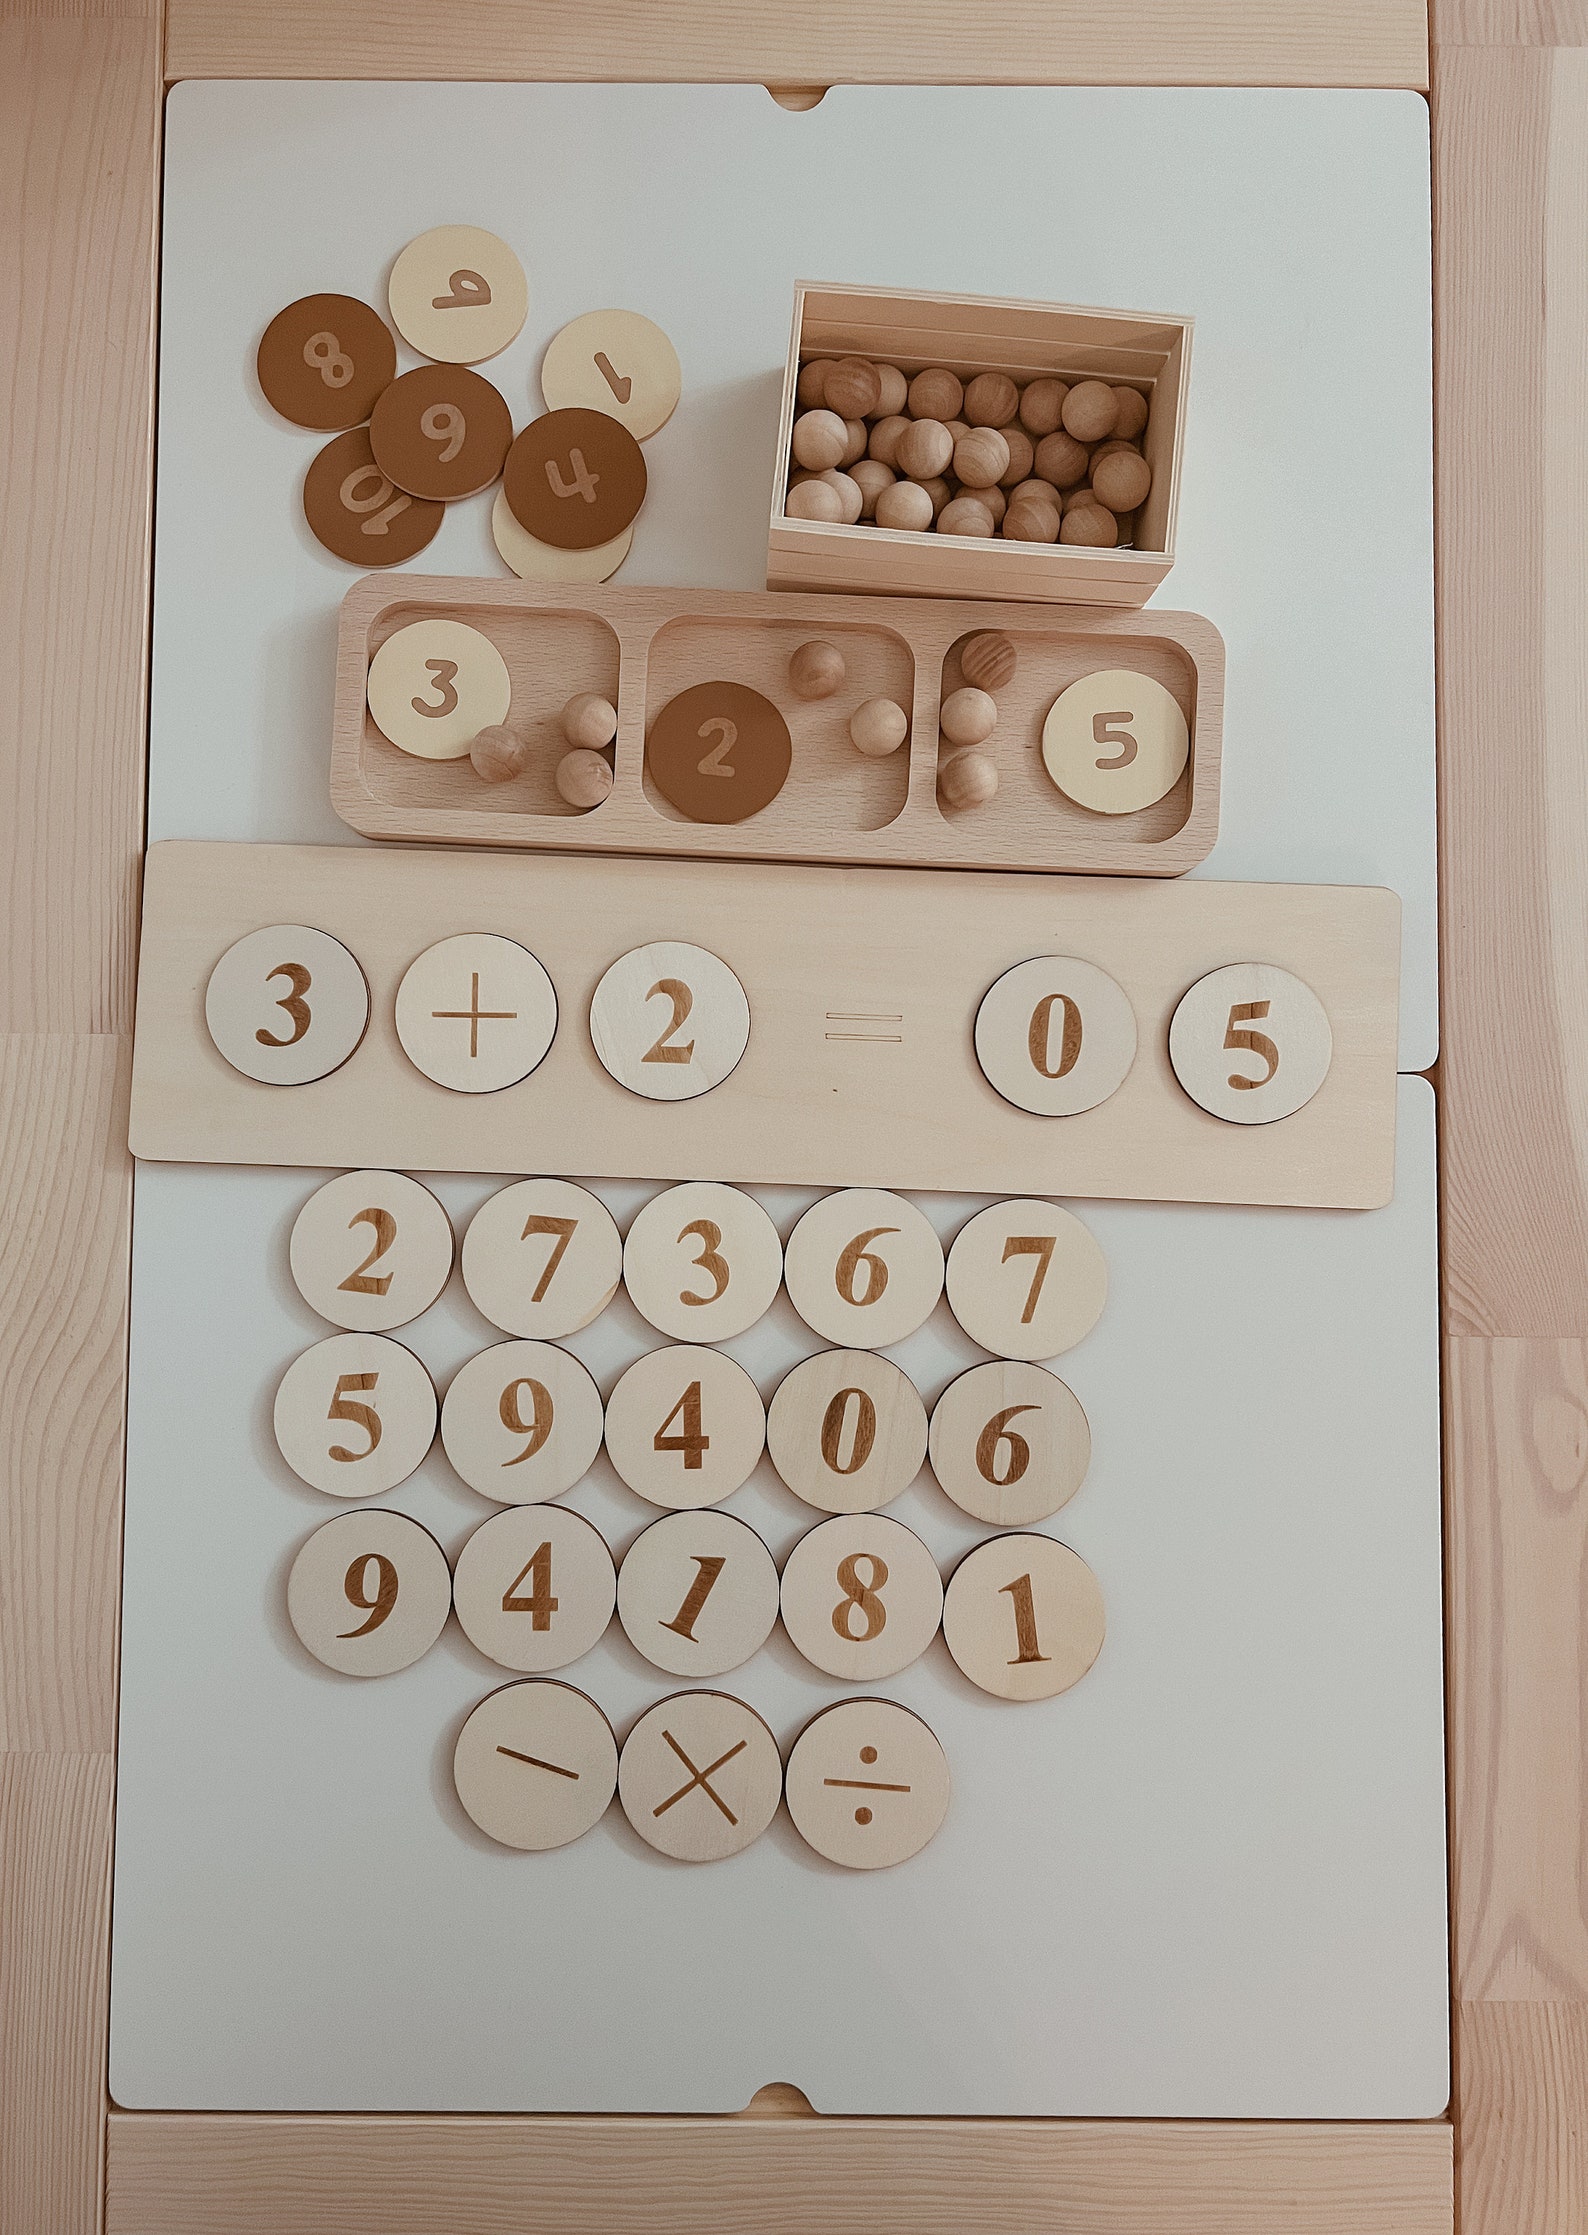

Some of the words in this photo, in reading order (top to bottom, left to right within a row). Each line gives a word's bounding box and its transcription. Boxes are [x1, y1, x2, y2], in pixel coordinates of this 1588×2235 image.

[302, 332, 354, 389] 8
[593, 352, 631, 404] 1
[545, 448, 599, 504] 4
[410, 659, 459, 719] 3
[696, 717, 738, 778] 2
[1091, 711, 1138, 771] 5
[256, 963, 311, 1048] 3
[641, 979, 694, 1064] 2
[1029, 994, 1082, 1079] 0
[1223, 1000, 1279, 1090] 5
[337, 1208, 396, 1296] 2
[521, 1215, 578, 1302] 7
[677, 1220, 730, 1306] 3
[835, 1228, 901, 1306] 6
[1002, 1237, 1056, 1323] 7
[327, 1373, 382, 1462] 5
[500, 1378, 553, 1467] 9
[654, 1381, 709, 1469] 4
[821, 1388, 876, 1474] 0
[976, 1405, 1042, 1486] 6
[336, 1553, 398, 1638] 9
[502, 1542, 558, 1631] 4
[658, 1556, 726, 1643] 1
[832, 1553, 888, 1642] 8
[998, 1574, 1052, 1665] 1
